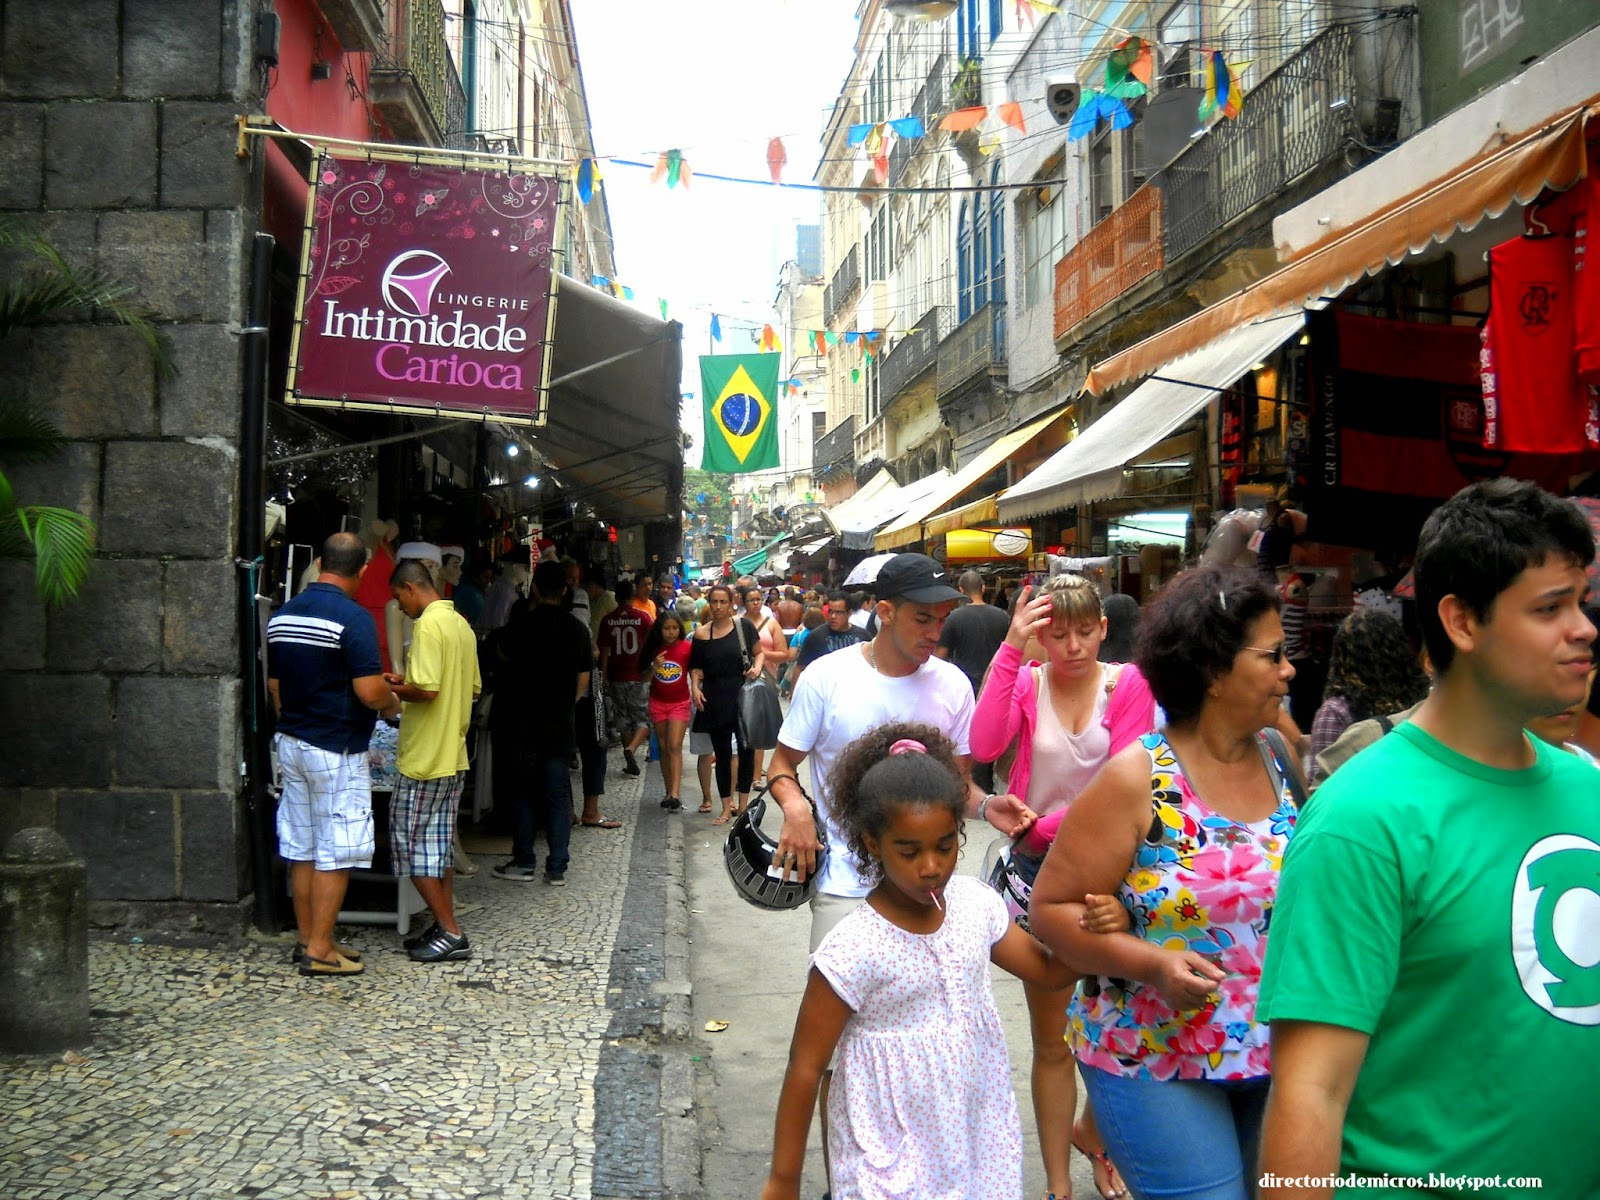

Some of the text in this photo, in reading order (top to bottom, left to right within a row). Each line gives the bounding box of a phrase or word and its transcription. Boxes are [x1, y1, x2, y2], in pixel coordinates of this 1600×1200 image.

[437, 292, 529, 311] LINGERIE
[320, 300, 527, 353] Intimidade
[375, 343, 524, 391] Carioca
[607, 617, 642, 626] Unimed
[611, 626, 639, 655] 10
